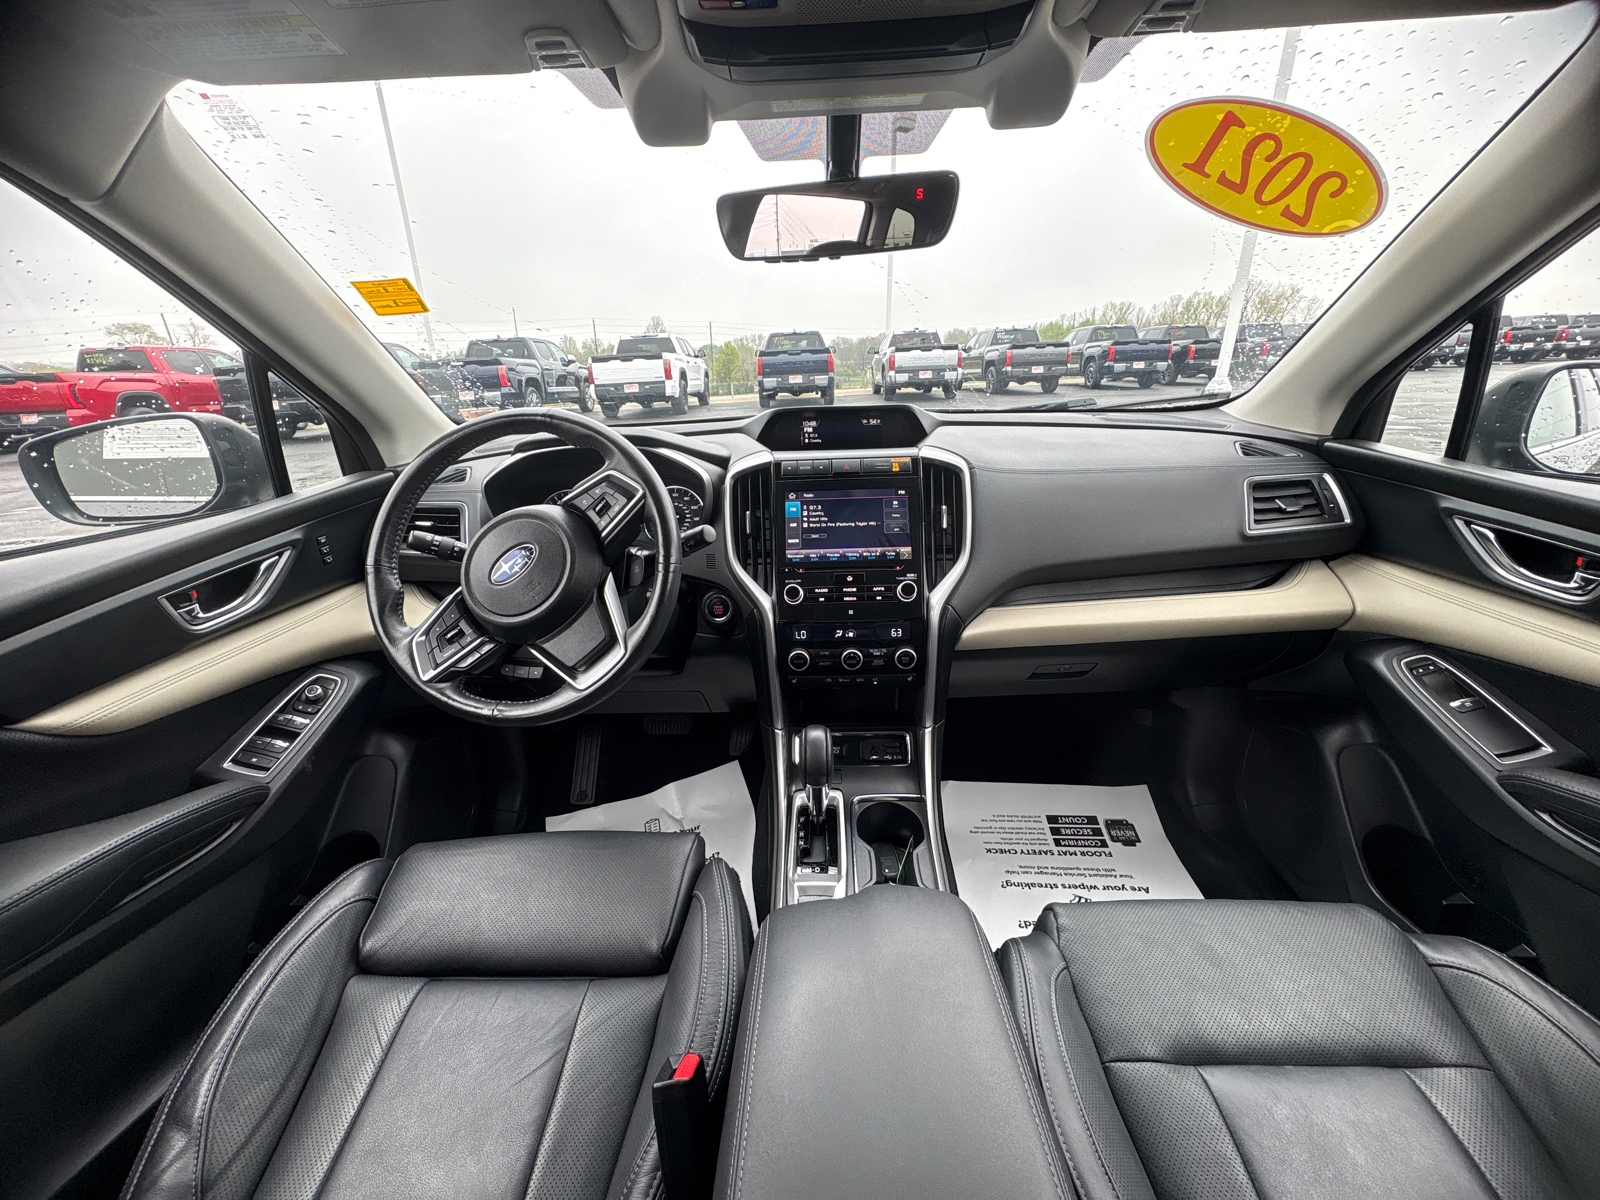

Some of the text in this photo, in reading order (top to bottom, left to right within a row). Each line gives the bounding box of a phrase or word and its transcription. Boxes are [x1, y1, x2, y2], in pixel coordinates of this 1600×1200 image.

[916, 188, 924, 200] S
[795, 630, 807, 639] LO
[890, 628, 902, 638] 63
[1001, 880, 1150, 894] Are your wipers streaking?
